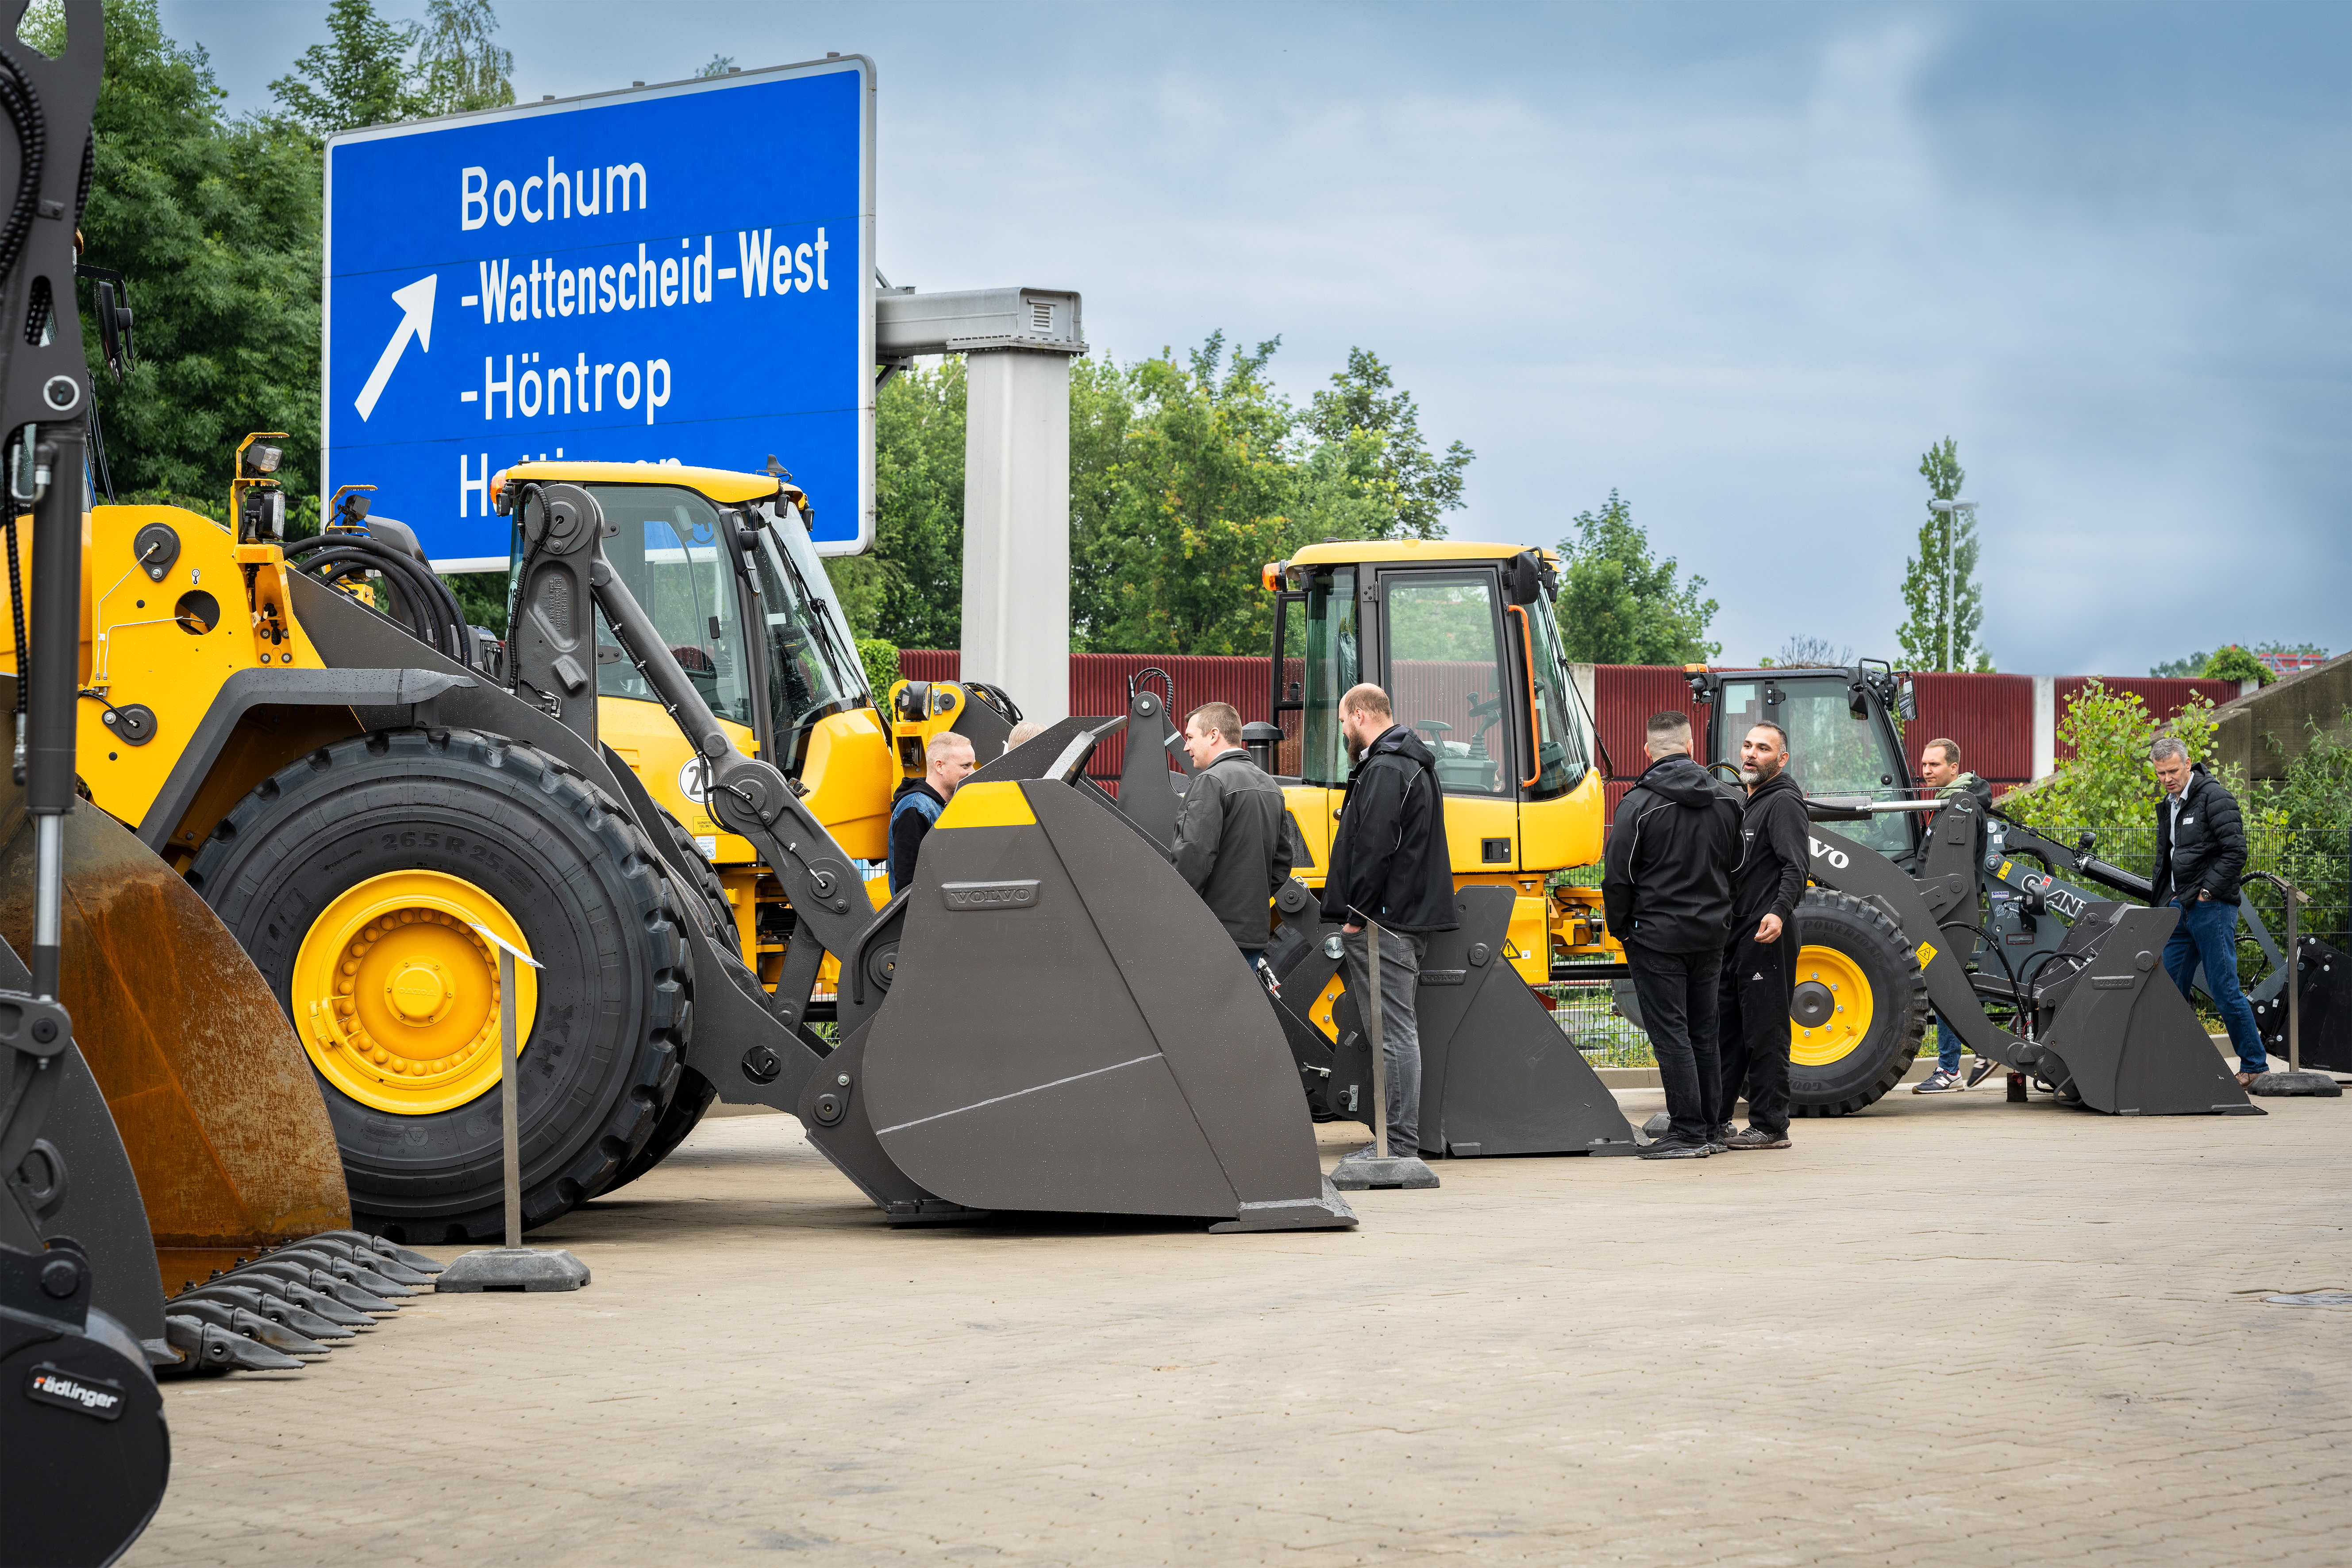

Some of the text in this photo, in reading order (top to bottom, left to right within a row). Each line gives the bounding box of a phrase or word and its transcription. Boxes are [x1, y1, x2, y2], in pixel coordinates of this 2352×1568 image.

[462, 156, 646, 231] Bochum
[461, 352, 670, 424] -Höntrop
[381, 831, 505, 871] 26.5 R 25
[951, 888, 1030, 903] VOLVO
[398, 987, 437, 996] VOLVO
[33, 1375, 118, 1408] rädlinger
